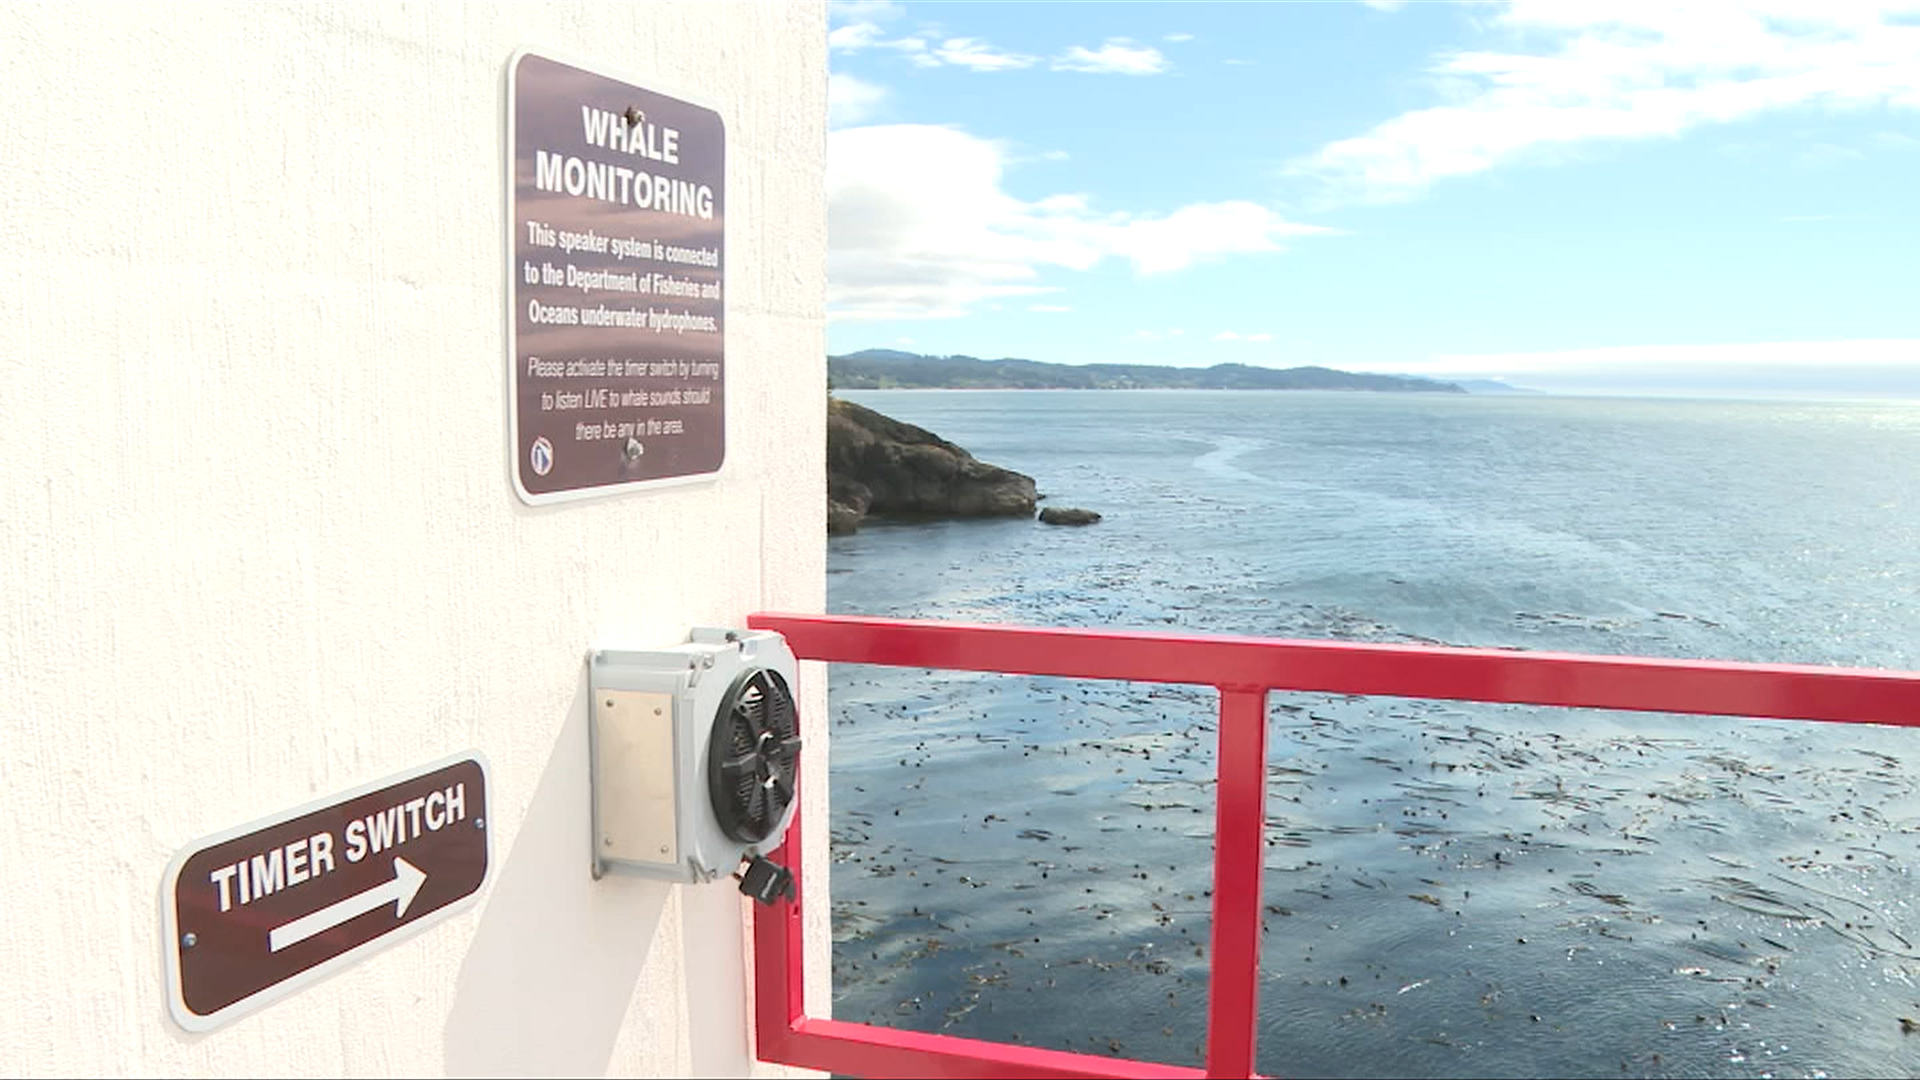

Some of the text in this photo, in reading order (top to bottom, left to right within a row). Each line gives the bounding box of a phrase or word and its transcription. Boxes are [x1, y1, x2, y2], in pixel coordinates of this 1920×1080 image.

[582, 105, 679, 164] WHALE
[536, 150, 713, 220] MONITORING
[527, 221, 718, 267] This speaker system is connected
[524, 261, 720, 299] to the Department of Fisheries and
[529, 299, 718, 334] Oceans underwater hydrophones.
[527, 357, 719, 380] Please activate the timer switch by turning
[541, 388, 711, 410] to listen LIVE to whale sounds should
[575, 421, 601, 440] there
[603, 420, 616, 439] be
[618, 422, 634, 440] any
[636, 419, 646, 436] in
[647, 418, 662, 435] the
[210, 783, 466, 912] TIMER SWITCH
